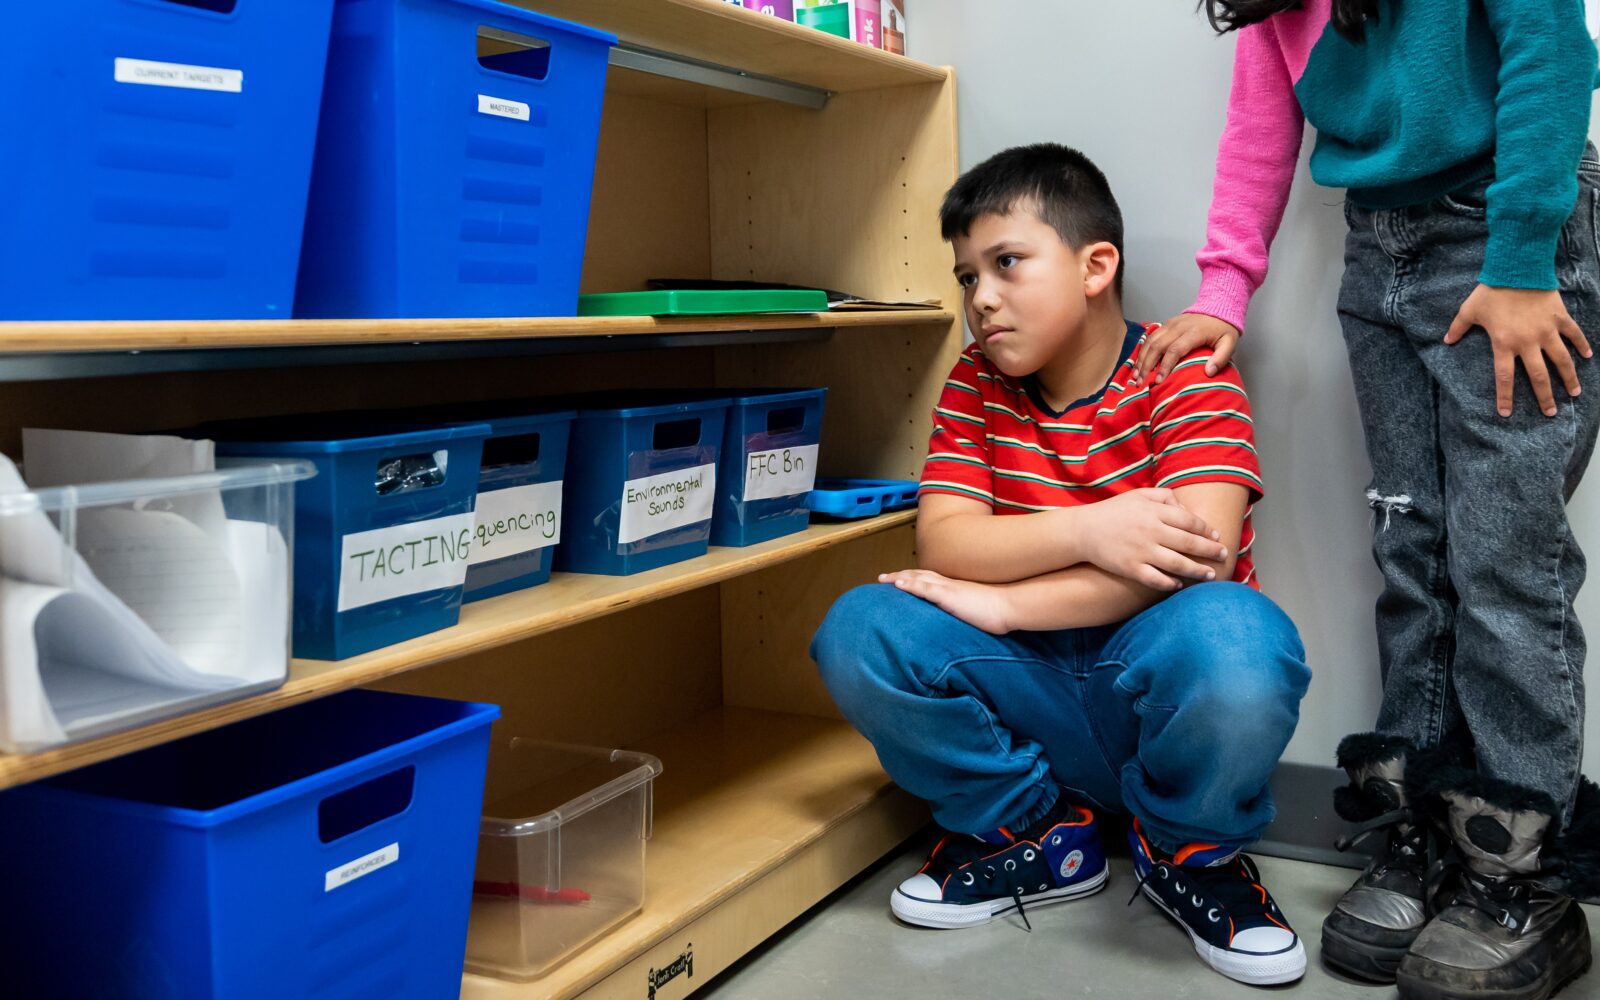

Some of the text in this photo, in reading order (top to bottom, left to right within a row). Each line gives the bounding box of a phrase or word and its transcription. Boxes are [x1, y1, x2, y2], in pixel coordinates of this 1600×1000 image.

[490, 103, 519, 114] MASTERED
[750, 449, 804, 479] FFC Bin
[627, 472, 703, 503] Environmental
[648, 496, 685, 516] Sounds
[472, 510, 556, 547] quencing
[350, 528, 471, 582] TACTING
